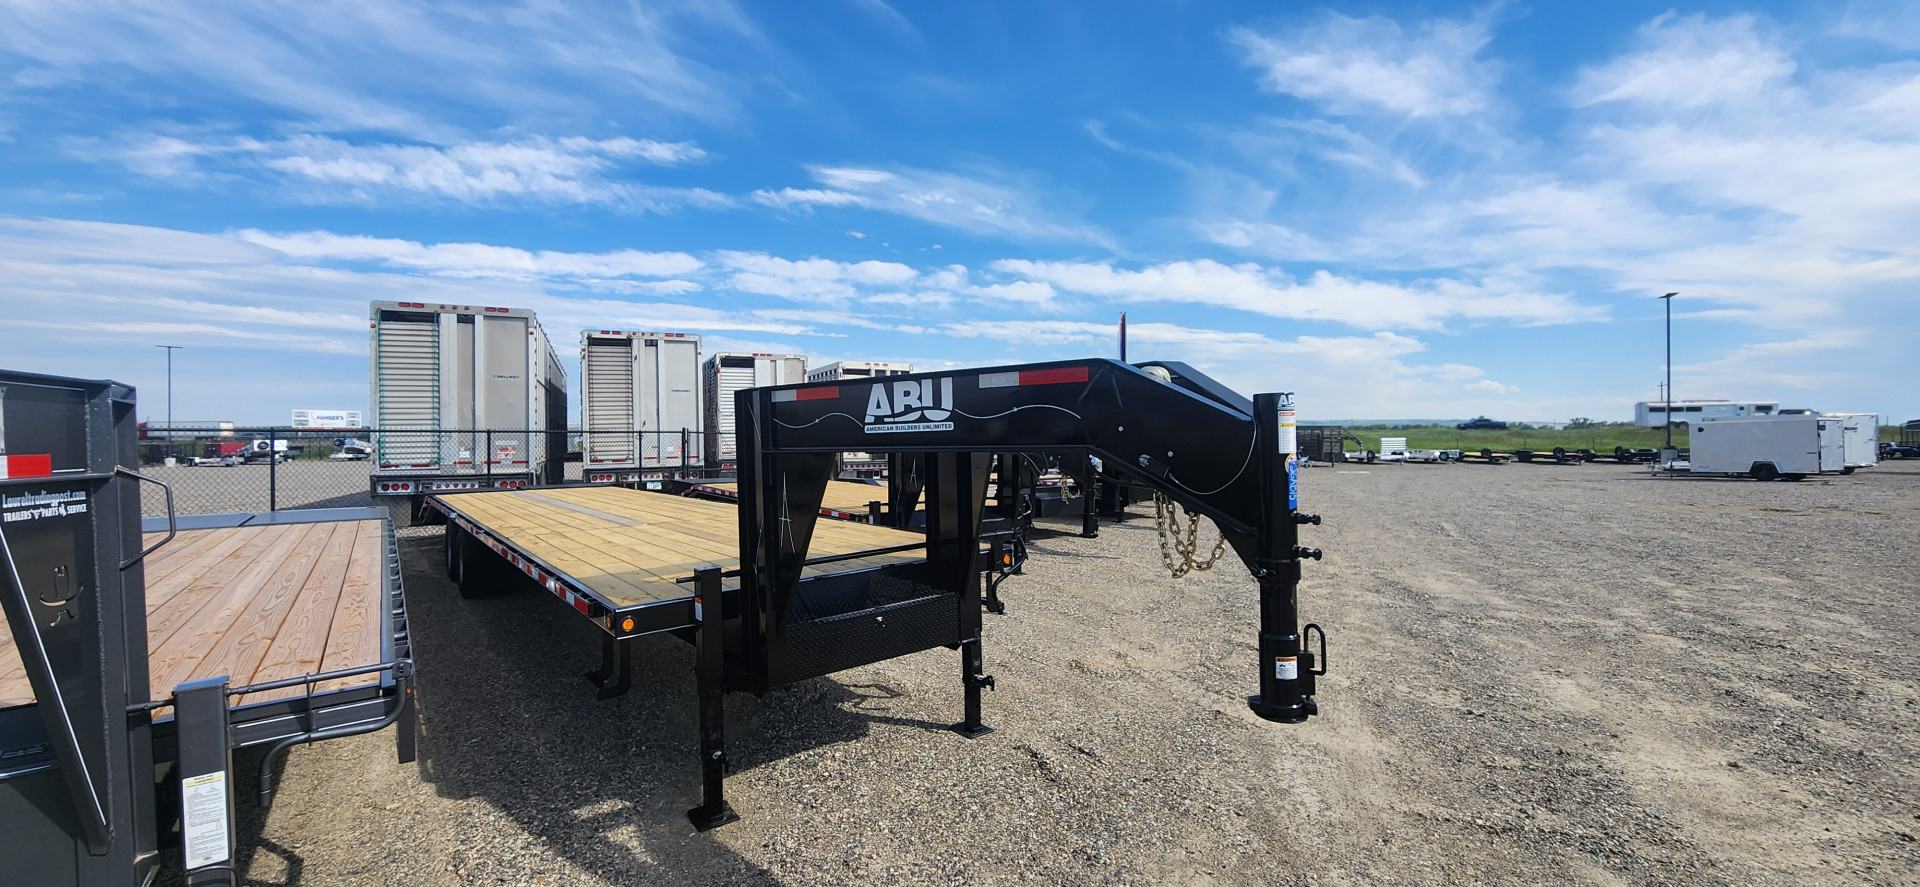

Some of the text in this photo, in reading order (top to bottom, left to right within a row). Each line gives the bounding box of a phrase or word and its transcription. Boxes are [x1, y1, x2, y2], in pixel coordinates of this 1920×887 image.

[864, 377, 953, 423] ABU
[2, 489, 87, 508] Laureltradingpost.com
[3, 504, 87, 522] TRAILERS PARTS SERVICE
